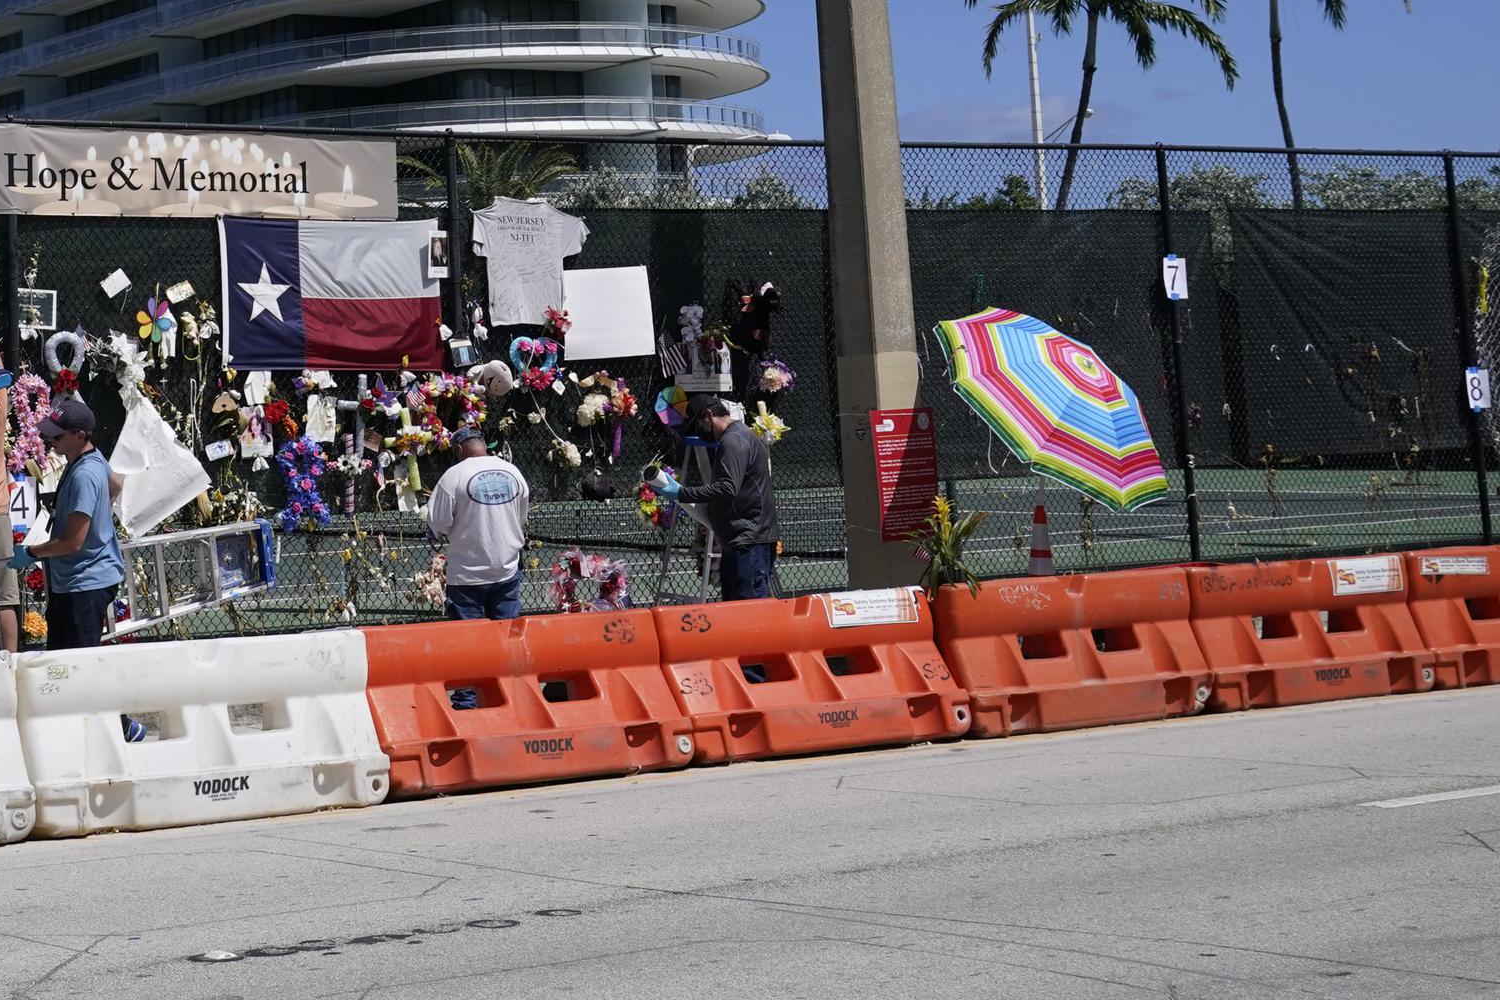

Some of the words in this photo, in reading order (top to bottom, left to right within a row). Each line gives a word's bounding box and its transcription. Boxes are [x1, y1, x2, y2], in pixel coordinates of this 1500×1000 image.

[4, 153, 98, 201] Hope
[107, 156, 143, 191] &
[150, 157, 310, 194] Memorial
[497, 215, 516, 224] NEW
[516, 216, 545, 226] JERSEY
[1167, 265, 1179, 291] 7
[1470, 376, 1483, 401] 8
[11, 486, 29, 519] 4
[818, 707, 859, 724] YODOCK
[523, 738, 574, 754] YODOCK
[193, 776, 249, 796] YODOCK
